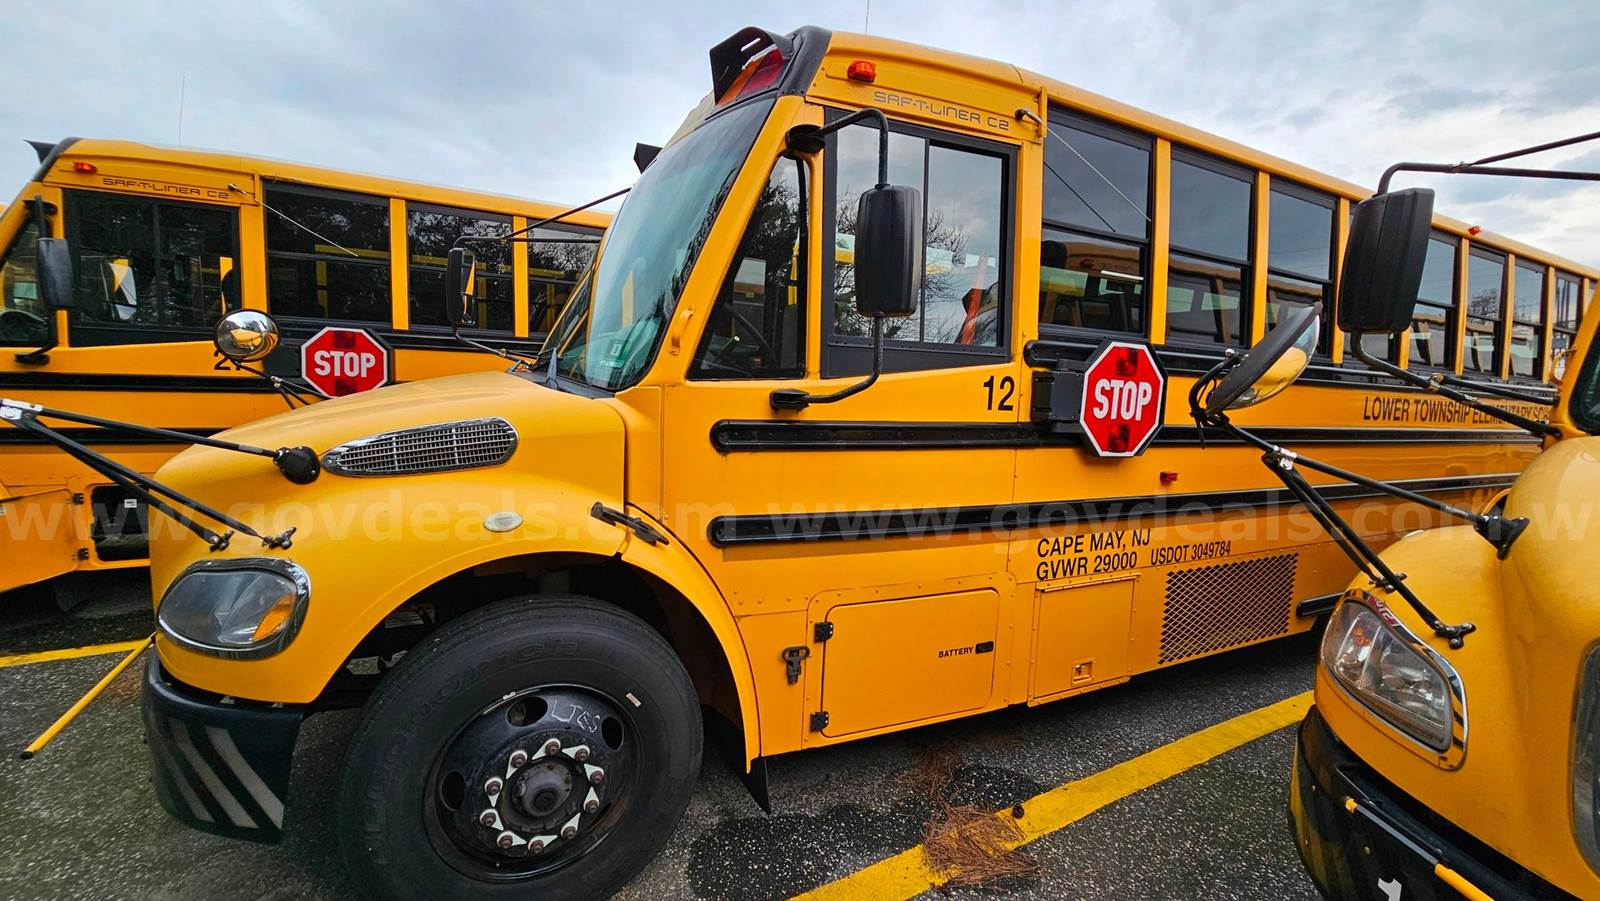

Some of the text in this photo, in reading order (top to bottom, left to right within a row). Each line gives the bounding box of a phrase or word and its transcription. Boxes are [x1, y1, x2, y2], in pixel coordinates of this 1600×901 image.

[987, 116, 1009, 131] C2
[207, 190, 229, 200] C2
[314, 350, 376, 378] STOP
[983, 375, 1015, 412] 12
[1093, 378, 1153, 421] STOP
[1363, 396, 1410, 421] LOWER
[1412, 399, 1470, 423] TOWNSHIP
[1037, 527, 1151, 558] CAPE MAY, NJ
[1150, 540, 1232, 566] USDOT 3049784
[1036, 551, 1138, 581] GVWR 29000
[938, 646, 974, 659] BATTERY
